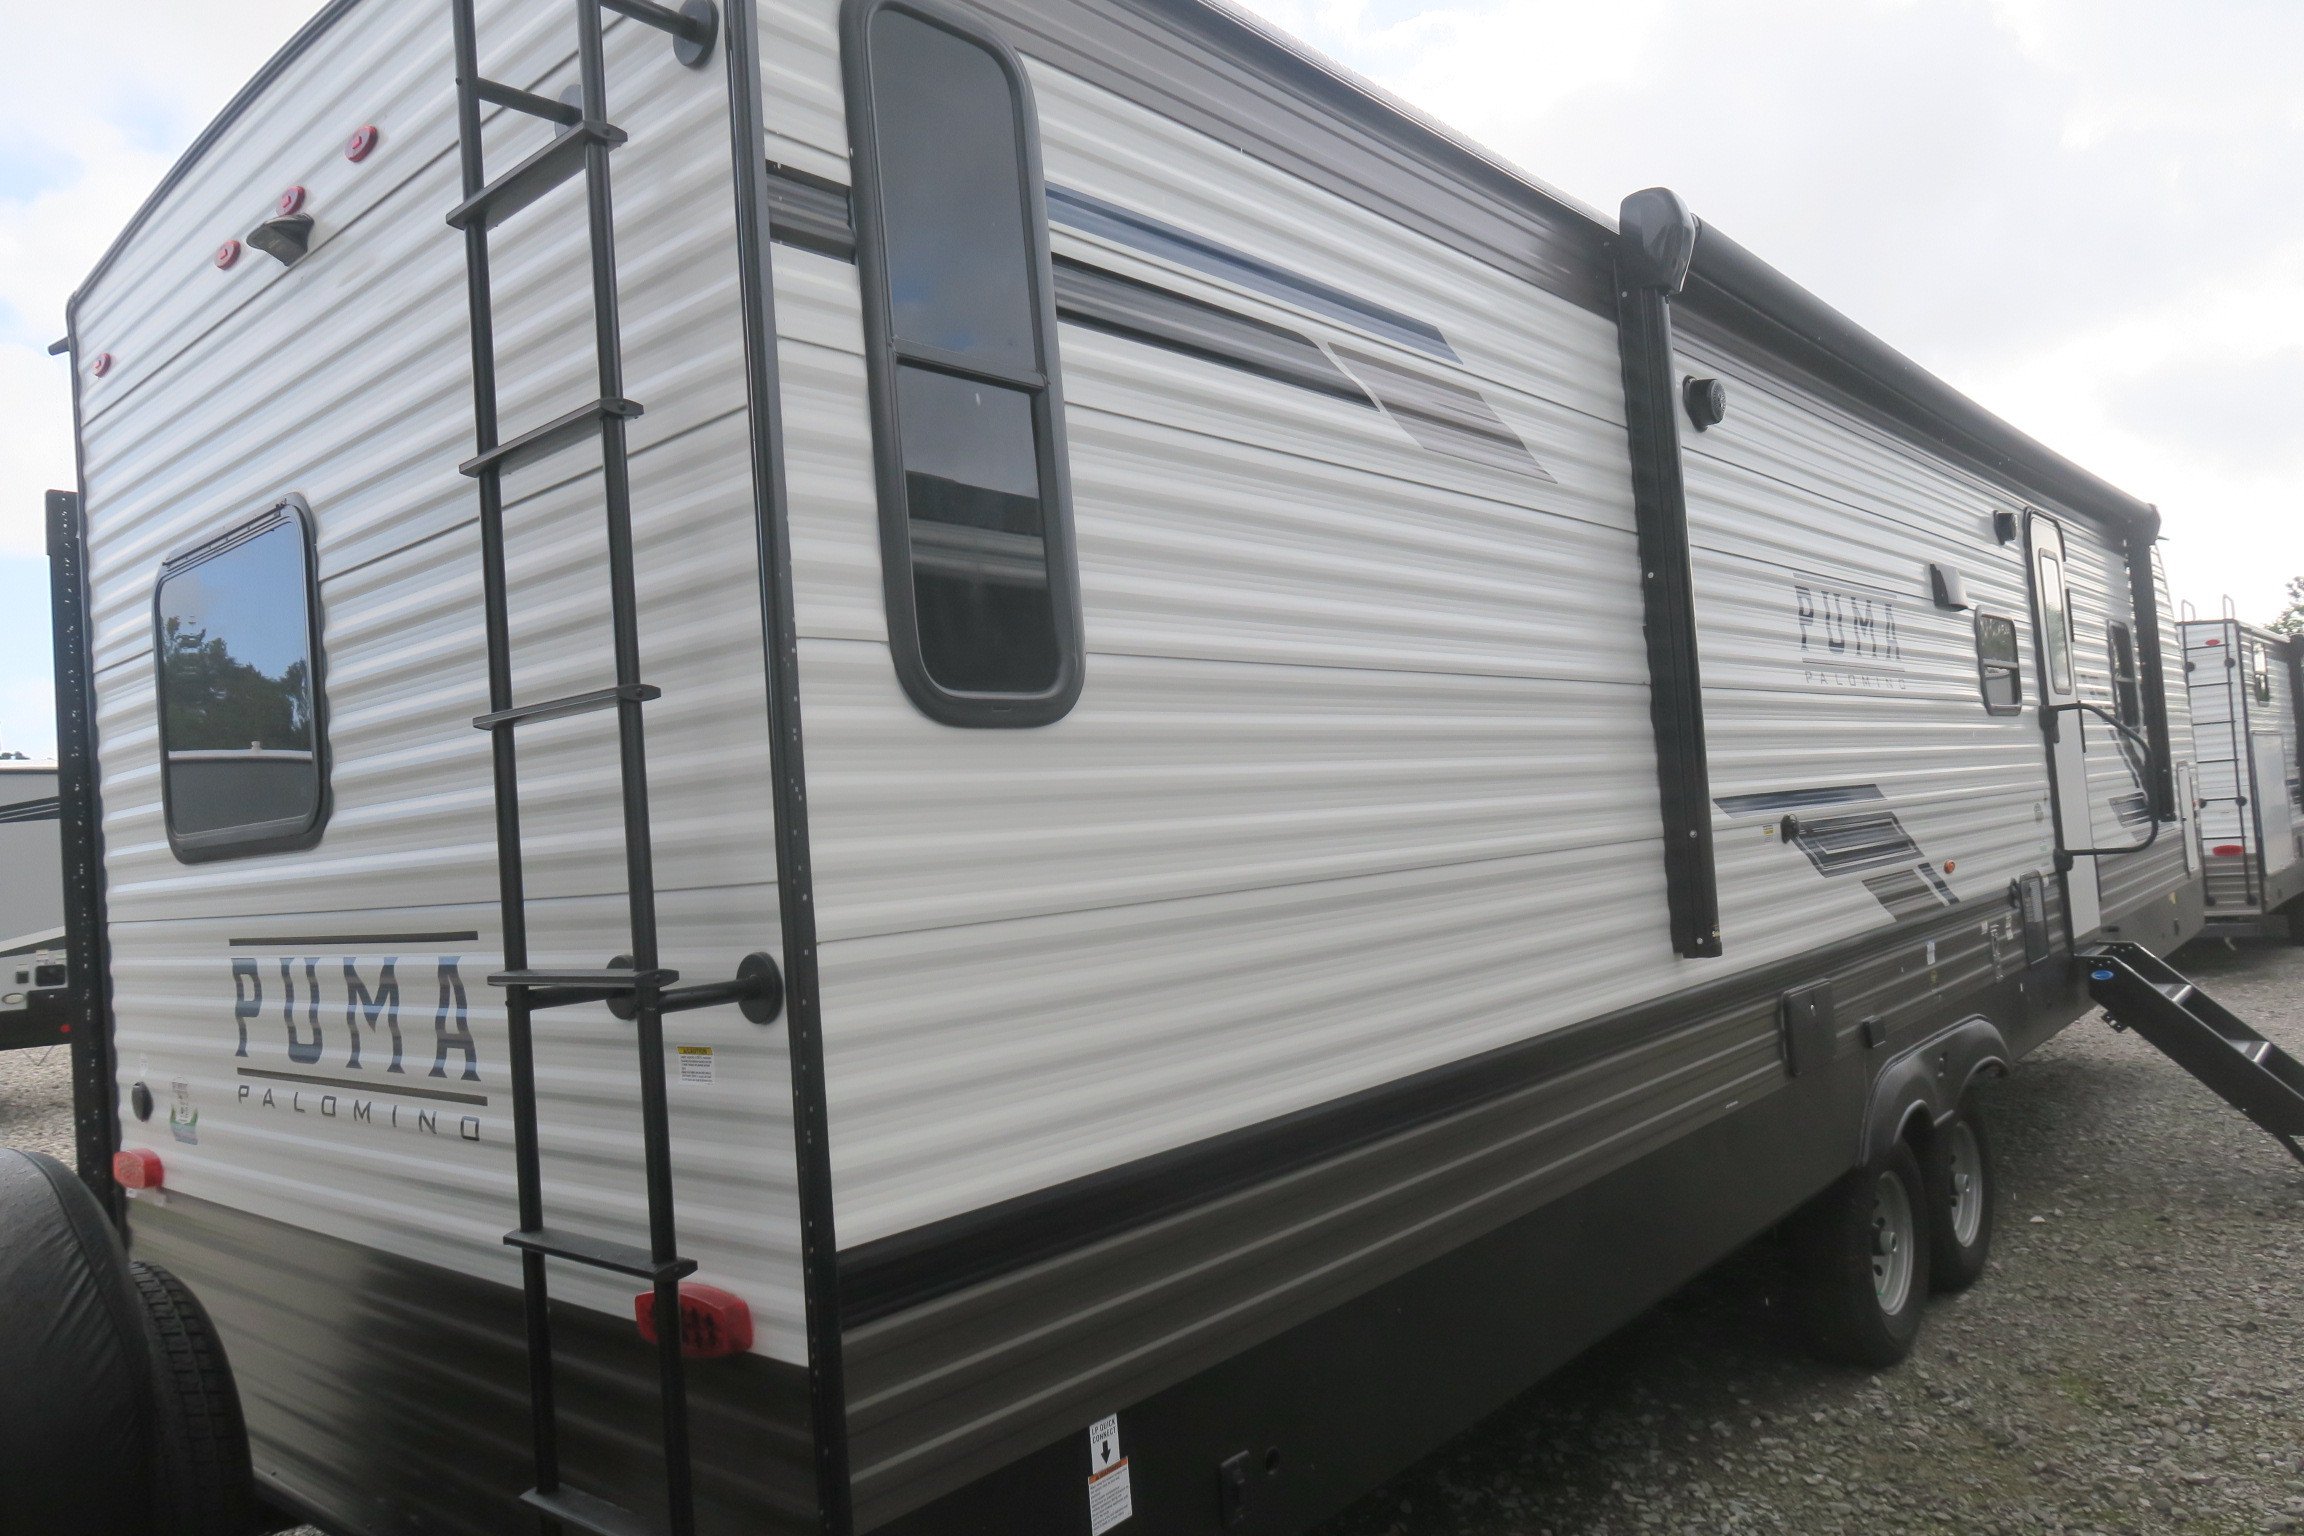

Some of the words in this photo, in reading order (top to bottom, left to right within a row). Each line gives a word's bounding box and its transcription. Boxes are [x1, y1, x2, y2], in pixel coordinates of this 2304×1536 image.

[1794, 585, 1901, 659] PUMA
[1805, 670, 1906, 690] PALOMINO
[231, 955, 482, 1082] PUMA
[237, 1084, 480, 1142] PALOMINO
[1091, 1426, 1099, 1435] LP
[1099, 1419, 1116, 1431] QUICK
[1092, 1427, 1116, 1444] CONNECT
